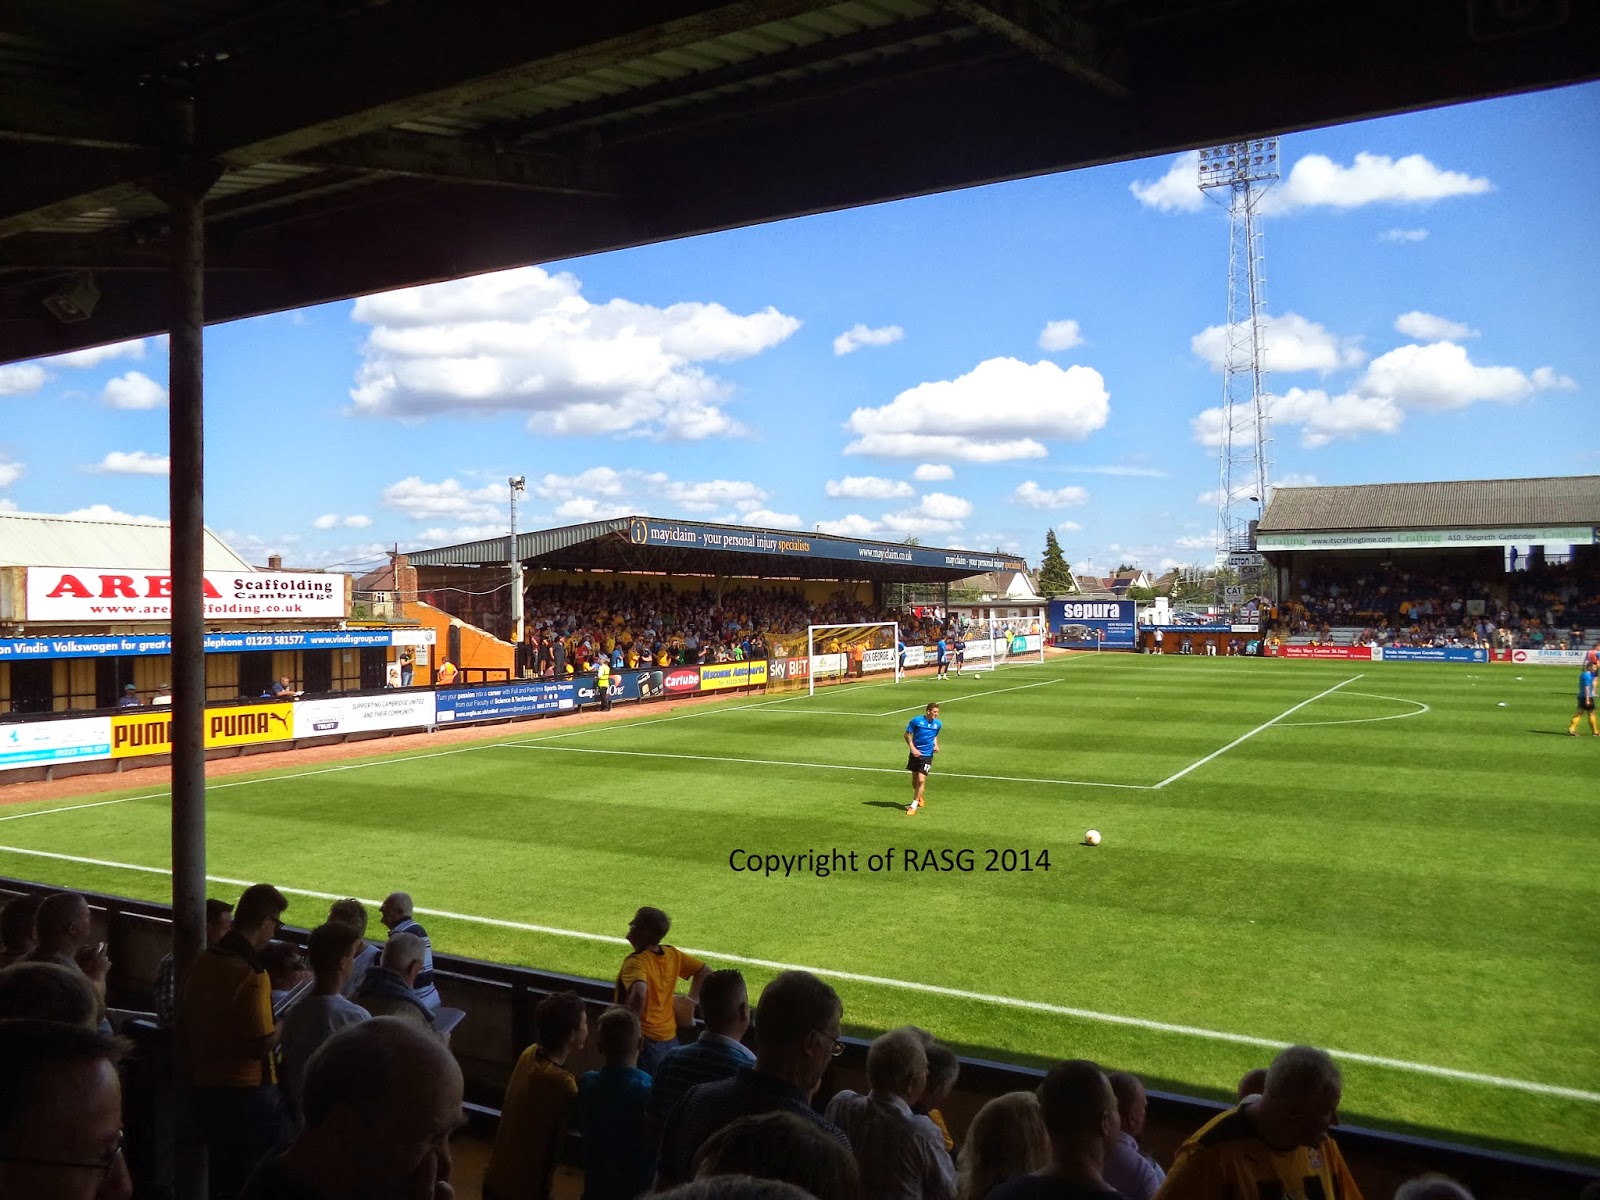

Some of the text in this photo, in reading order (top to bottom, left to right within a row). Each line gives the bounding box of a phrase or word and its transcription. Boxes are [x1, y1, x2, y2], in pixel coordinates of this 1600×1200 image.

[651, 526, 697, 543] mayiclaim
[703, 533, 722, 546] your
[723, 534, 755, 548] personal
[756, 536, 778, 552] injury
[778, 540, 810, 554] specialists
[1311, 536, 1393, 544] www.itscraftingtime.com
[1397, 531, 1442, 544] Crafting
[233, 578, 333, 593] Scaffolding
[1226, 587, 1241, 595] CAT
[234, 592, 333, 600] Cambridge
[1064, 603, 1120, 619] sepura
[14, 643, 49, 653] Vindis
[53, 642, 118, 653] Volkswagen
[121, 640, 136, 650] for
[139, 641, 166, 652] great
[204, 635, 243, 648] elephone
[246, 636, 272, 646] 01223
[311, 634, 389, 645] www.vindisgroup.com
[872, 650, 889, 662] GEORGE
[770, 660, 786, 678] sky
[789, 660, 808, 675] BET
[665, 674, 699, 687] Carlube
[457, 692, 476, 700] passion
[494, 695, 511, 704] Science
[352, 702, 382, 710] SUPPORTING
[382, 699, 408, 708] CAMBRIDGE
[374, 709, 388, 718] THEIR
[388, 707, 415, 716] COMMUNITY
[210, 713, 269, 738] PUMA
[316, 722, 336, 730] TRUST
